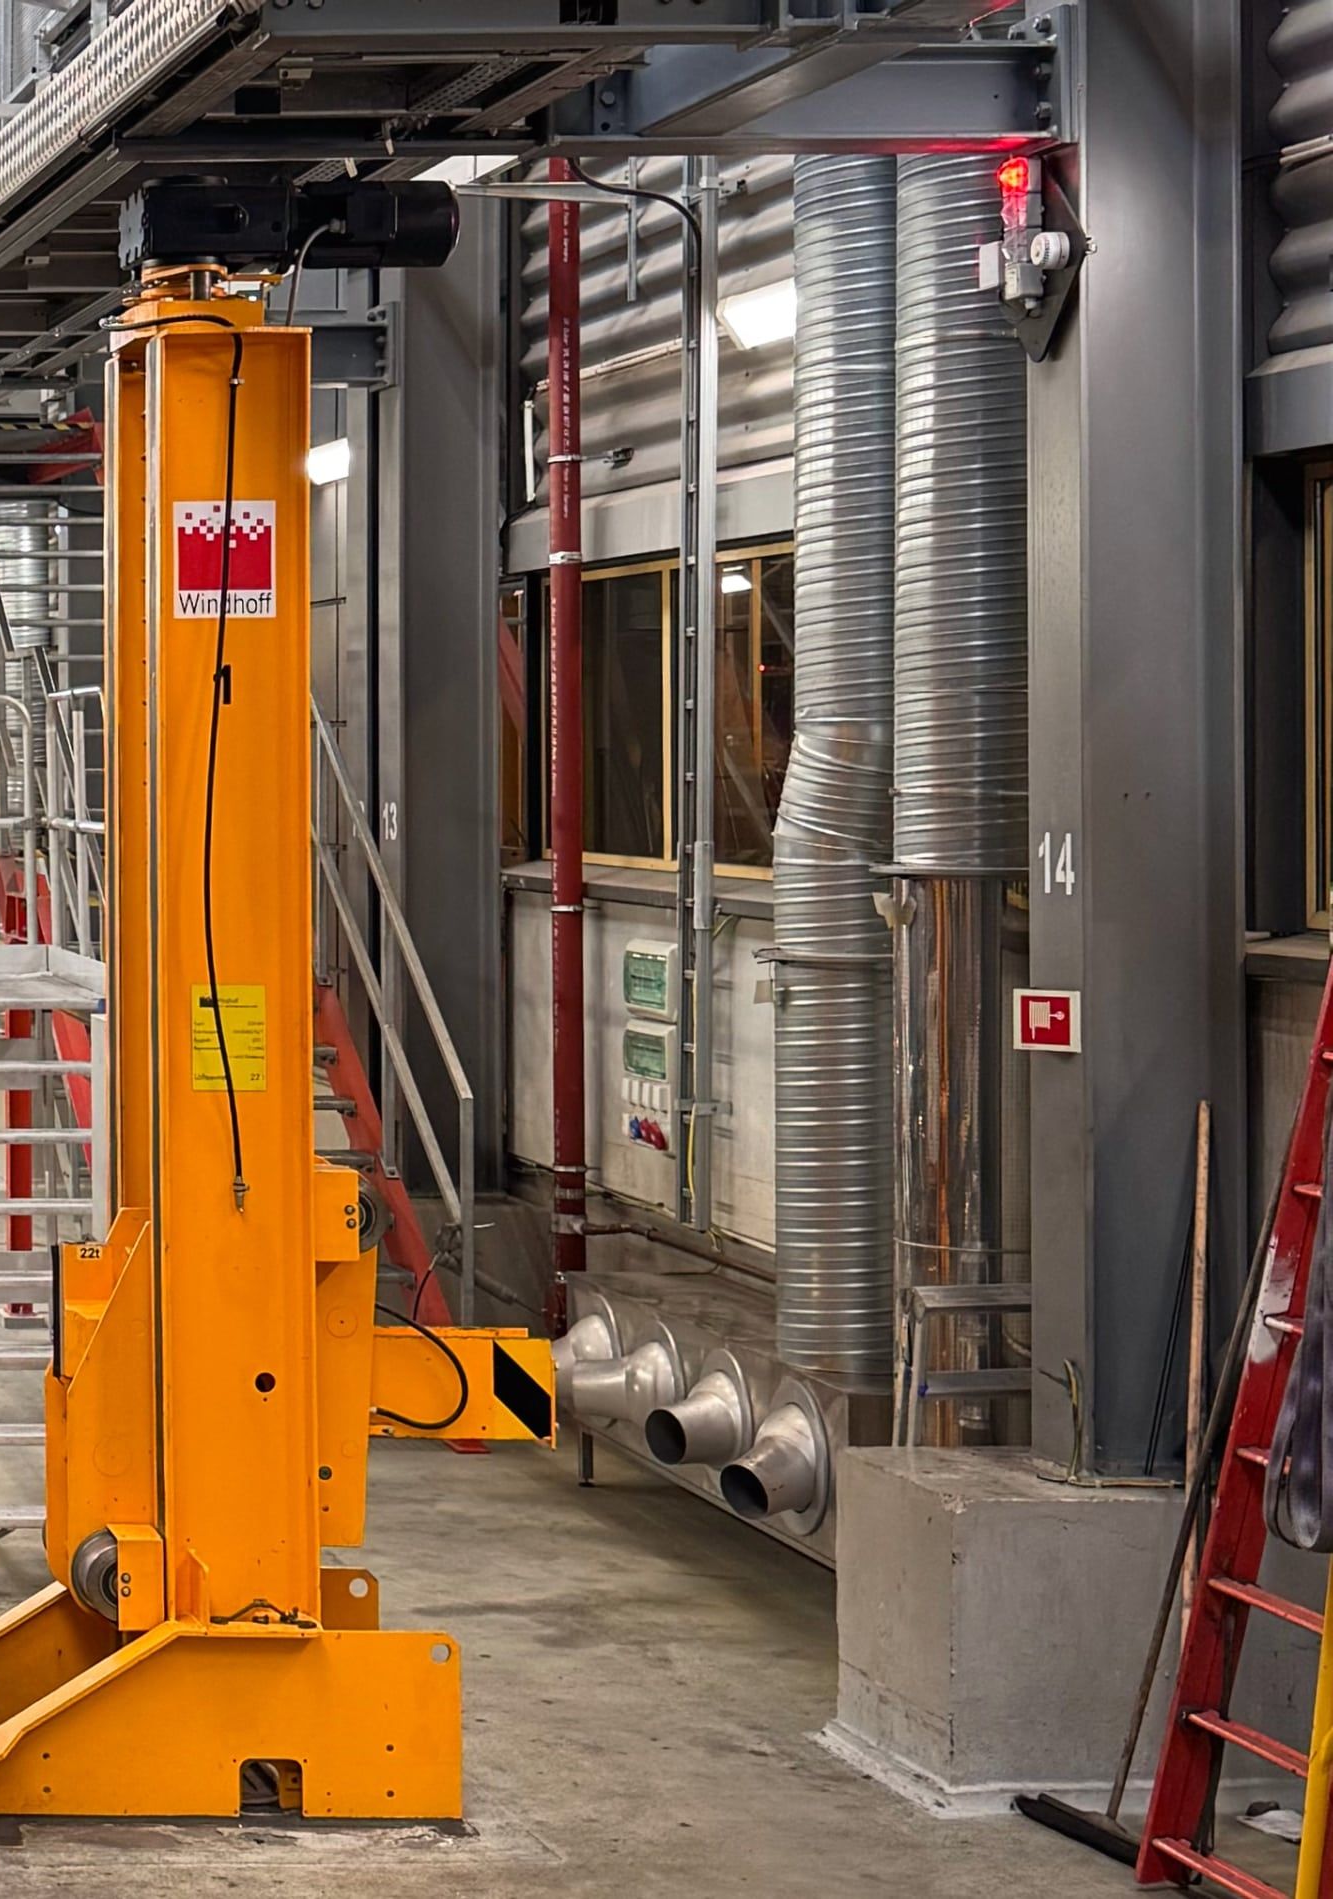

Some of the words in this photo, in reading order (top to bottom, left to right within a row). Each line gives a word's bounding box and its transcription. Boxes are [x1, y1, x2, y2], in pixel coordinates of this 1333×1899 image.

[179, 592, 272, 614] Windhoff
[213, 664, 232, 704] 1
[382, 802, 398, 841] 13
[1037, 831, 1075, 896] 14
[80, 1247, 100, 1259] 22t
